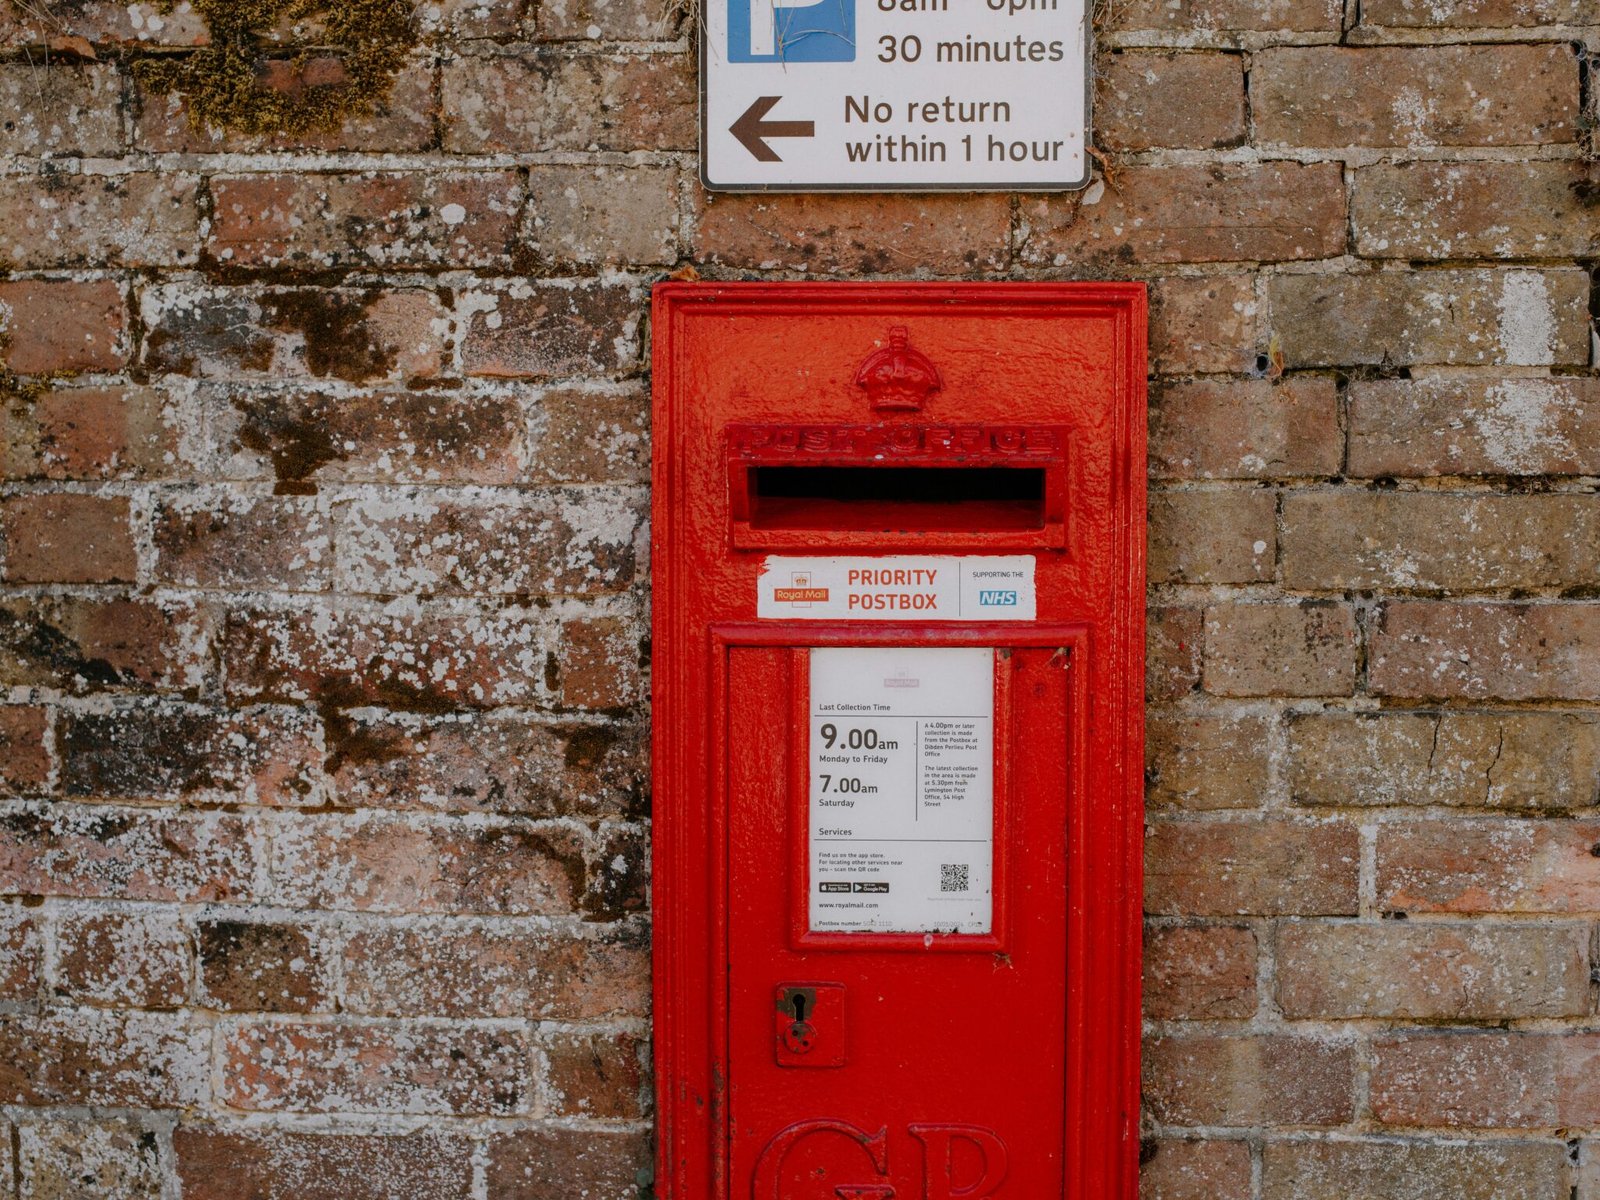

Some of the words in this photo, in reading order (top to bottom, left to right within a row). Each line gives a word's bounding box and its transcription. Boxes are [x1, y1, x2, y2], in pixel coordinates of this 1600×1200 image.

[878, 35, 922, 62] 30
[937, 34, 1064, 62] minutes
[845, 96, 892, 123] No
[908, 97, 1010, 122] return
[846, 135, 945, 162] within
[962, 135, 971, 161] 1
[988, 135, 1064, 161] hour
[849, 570, 937, 585] PRIORITY
[777, 590, 803, 601] Royal
[805, 590, 826, 599] Mail
[848, 594, 937, 609] POSTBOX
[982, 593, 1014, 604] NHS
[821, 724, 898, 750] 9.00am
[819, 755, 850, 763] Monday
[863, 755, 888, 764] Friday
[819, 775, 878, 793] 7.00am
[819, 799, 855, 808] Saturday
